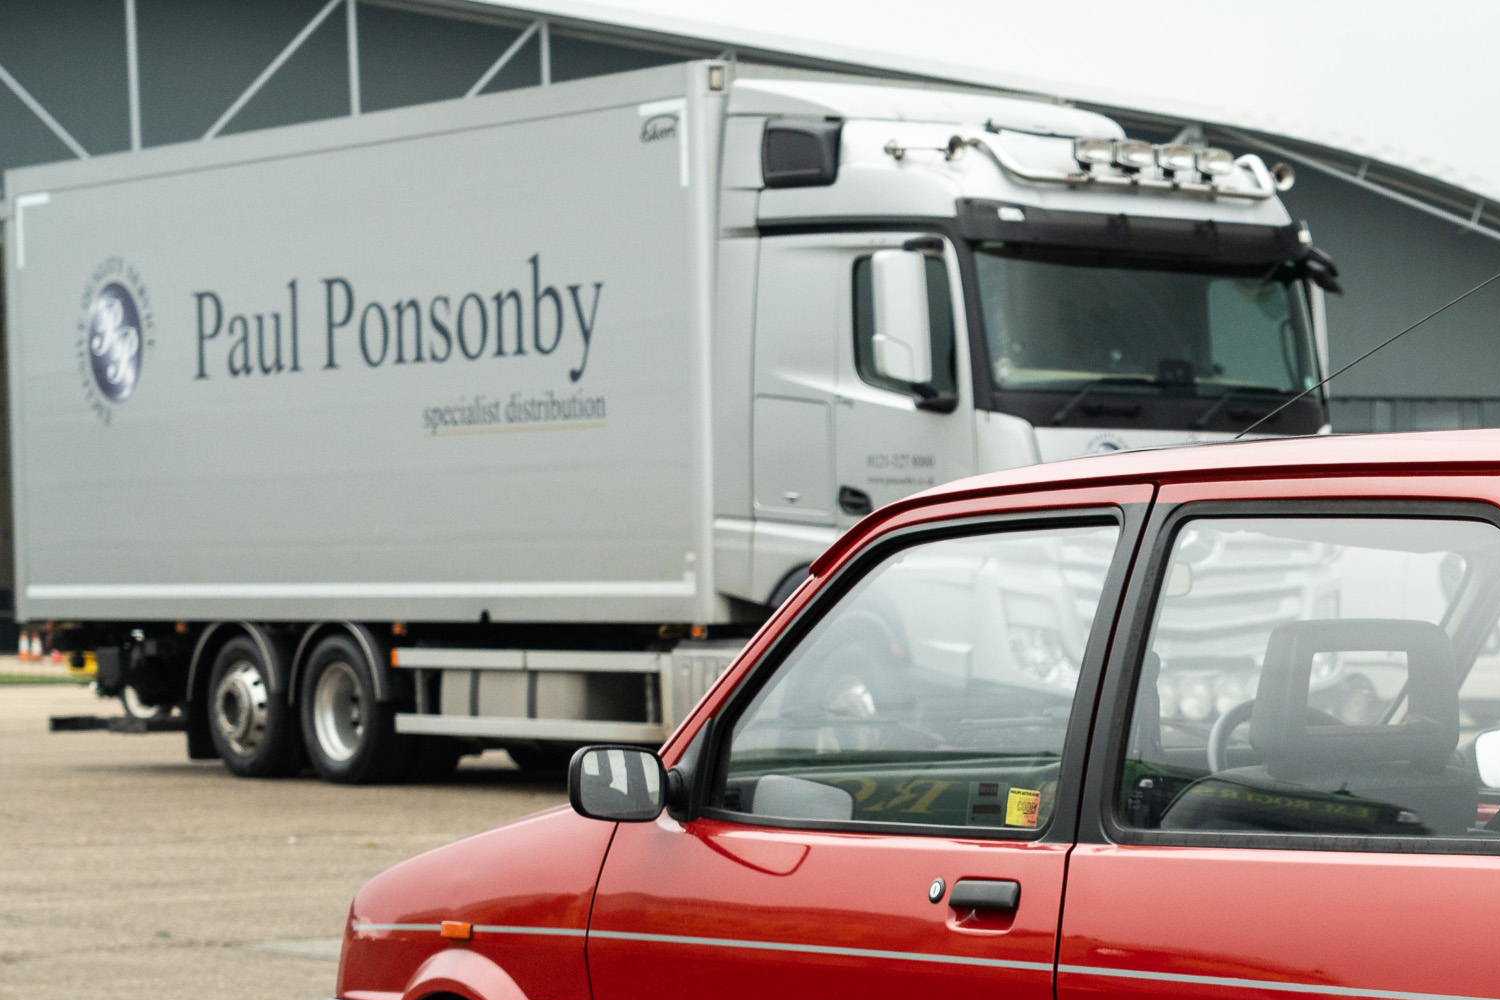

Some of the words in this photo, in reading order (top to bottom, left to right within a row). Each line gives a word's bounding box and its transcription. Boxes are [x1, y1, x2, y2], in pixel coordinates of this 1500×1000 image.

[193, 278, 302, 381] Paul
[321, 253, 604, 382] Ponsonby
[423, 394, 501, 435] specialist
[505, 387, 607, 425] distribution
